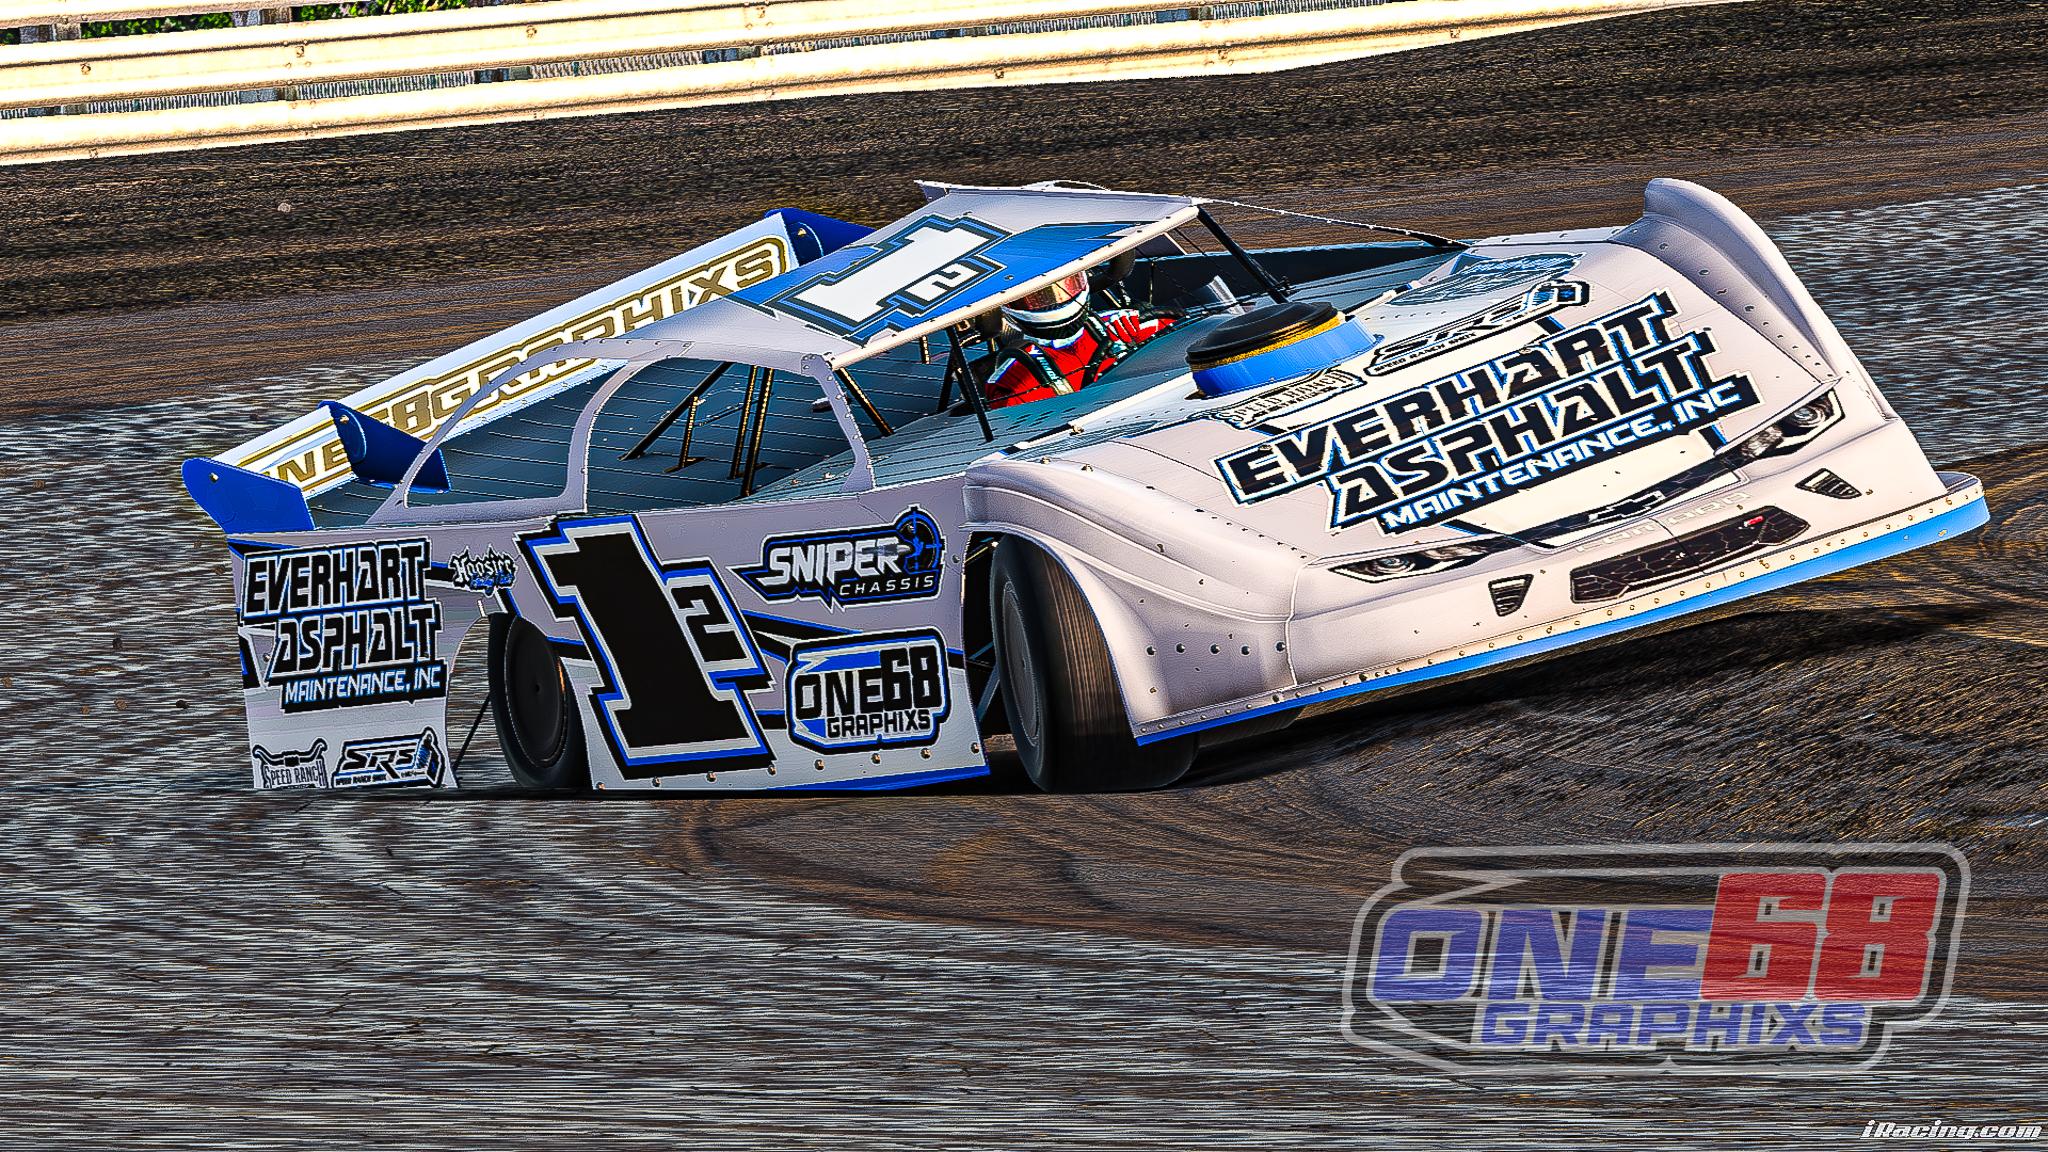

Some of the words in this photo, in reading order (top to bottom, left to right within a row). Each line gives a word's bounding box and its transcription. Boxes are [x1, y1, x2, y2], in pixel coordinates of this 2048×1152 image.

[1229, 302, 1676, 495] EVERHART
[1337, 344, 1714, 522] ASPHALT
[1382, 415, 1674, 534] MAINTENANCE,
[1676, 386, 1742, 424] INC
[245, 551, 424, 615] EVERHART
[758, 536, 902, 587] SNIPER
[839, 575, 934, 596] CHASSIS
[271, 611, 433, 673] ASPHALT
[286, 674, 410, 704] MAINTENANCE,
[414, 666, 441, 689] INC
[797, 645, 940, 720] ONE68
[827, 709, 931, 738] GRAPHIXS
[264, 766, 293, 788] SPEED
[294, 760, 327, 786] RANCH
